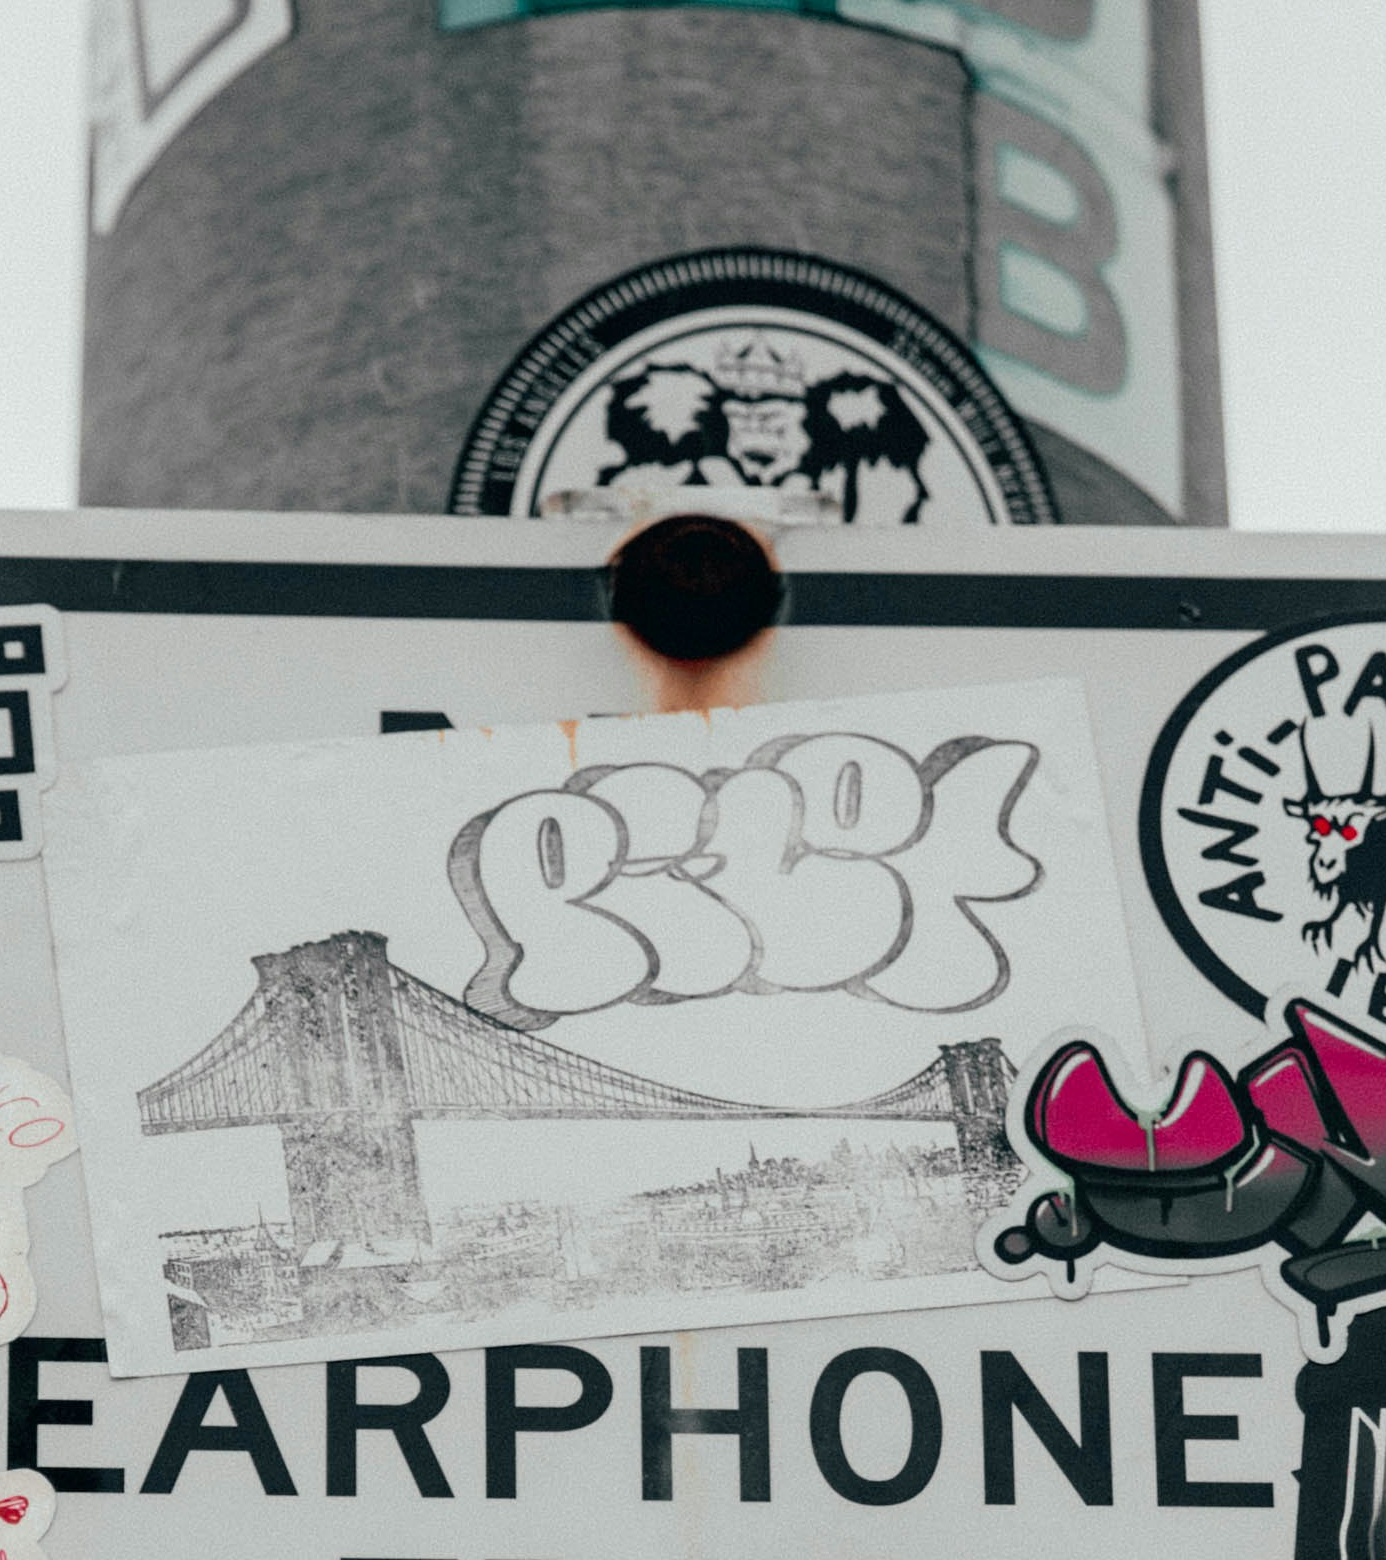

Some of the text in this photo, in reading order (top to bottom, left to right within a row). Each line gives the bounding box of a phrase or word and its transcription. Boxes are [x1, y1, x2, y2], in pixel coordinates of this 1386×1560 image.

[489, 330, 607, 483] LOS ANGELES
[8, 1339, 1307, 1510] EARPHONE
